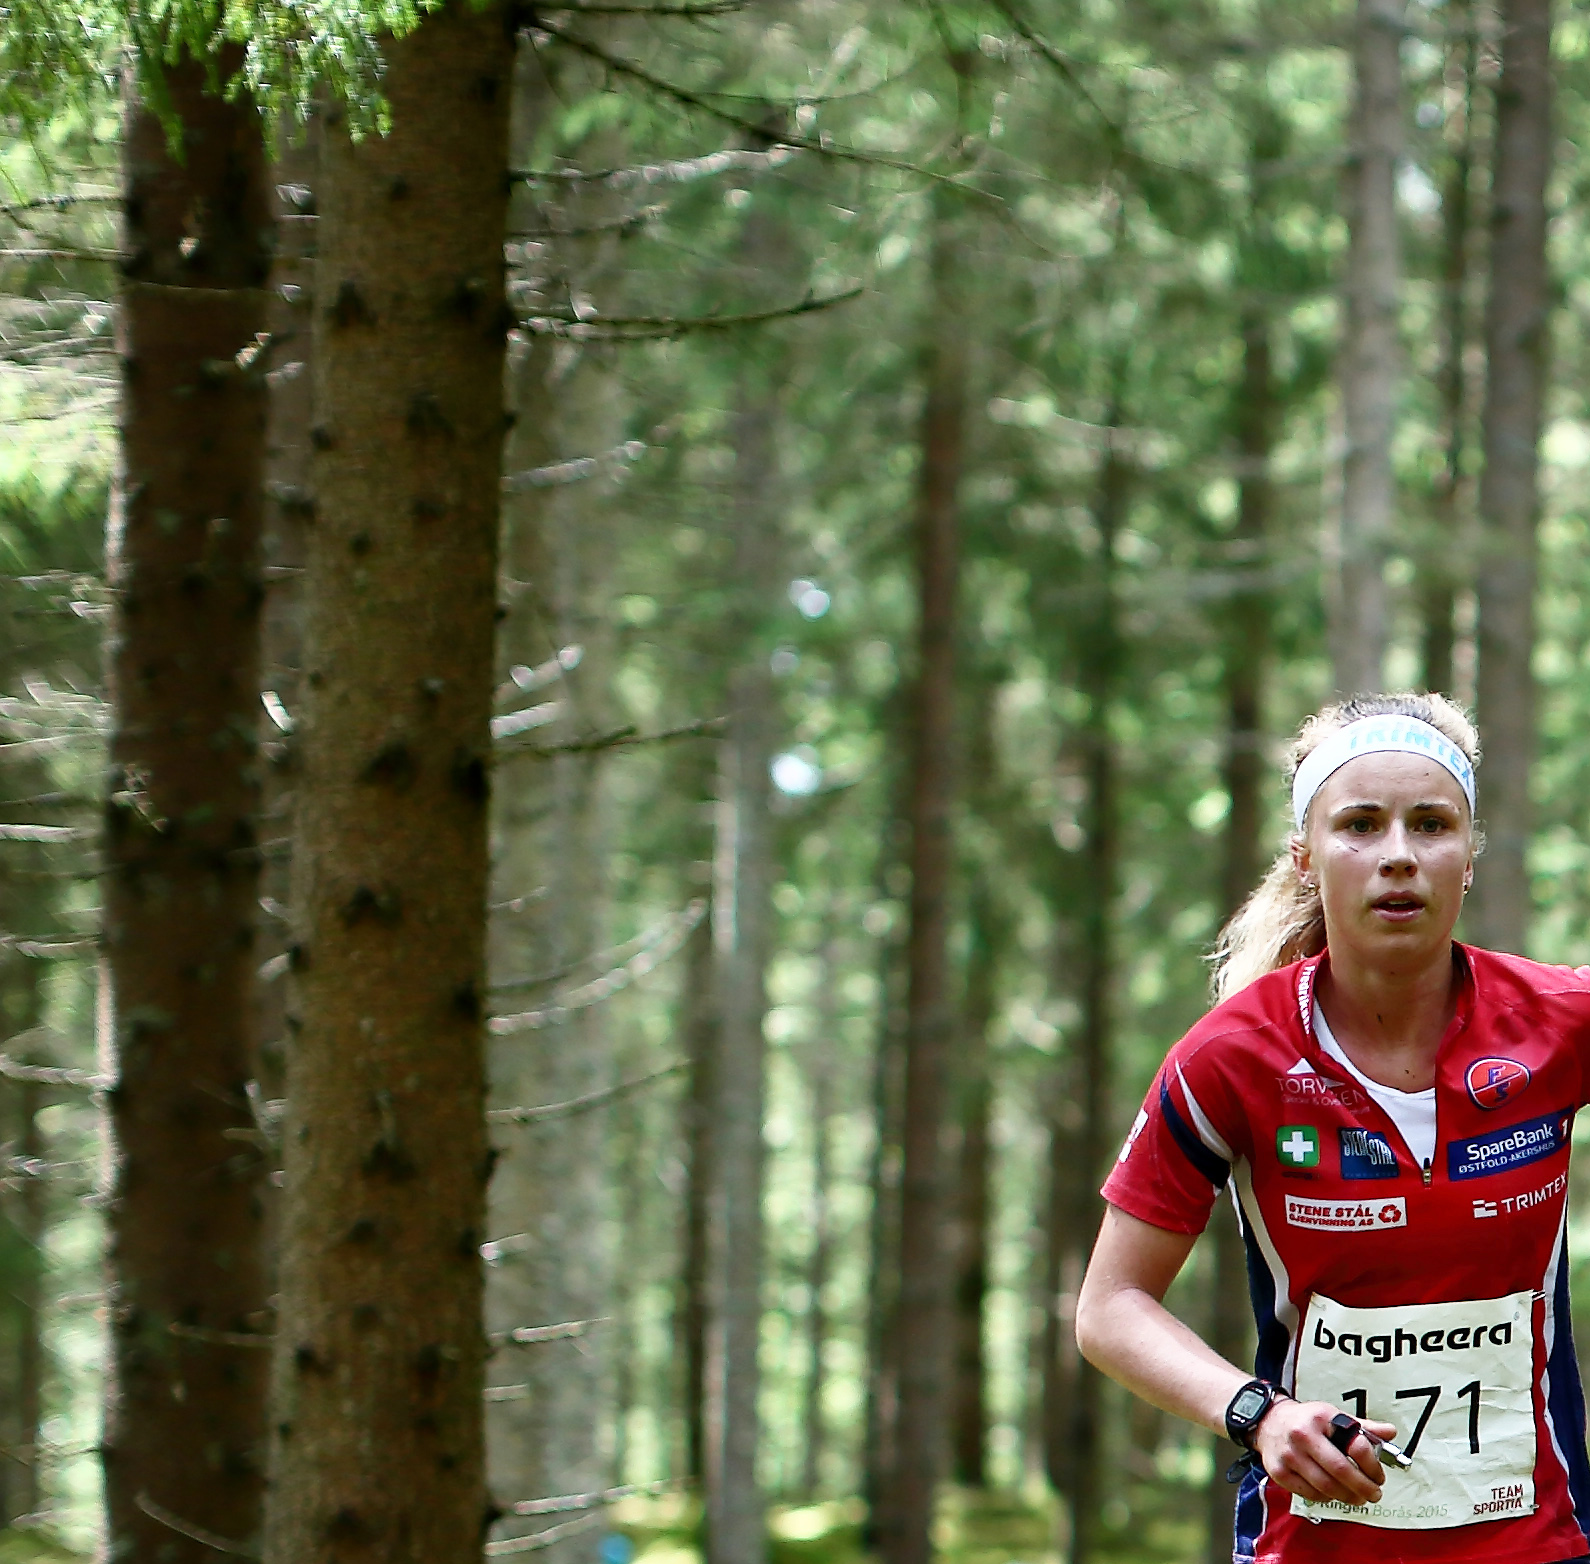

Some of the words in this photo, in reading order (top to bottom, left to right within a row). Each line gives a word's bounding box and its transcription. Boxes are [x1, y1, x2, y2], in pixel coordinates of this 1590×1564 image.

[1466, 1123, 1554, 1161] SpareBank
[1501, 1171, 1568, 1213] TRIMTEX
[1288, 1202, 1332, 1218] STENE
[1335, 1204, 1374, 1218] STÅL
[1313, 1318, 1512, 1363] bagheera
[1491, 1484, 1523, 1499] TEAM
[1416, 1503, 1448, 1518] 2015
[1473, 1497, 1522, 1515] SPORTIA
